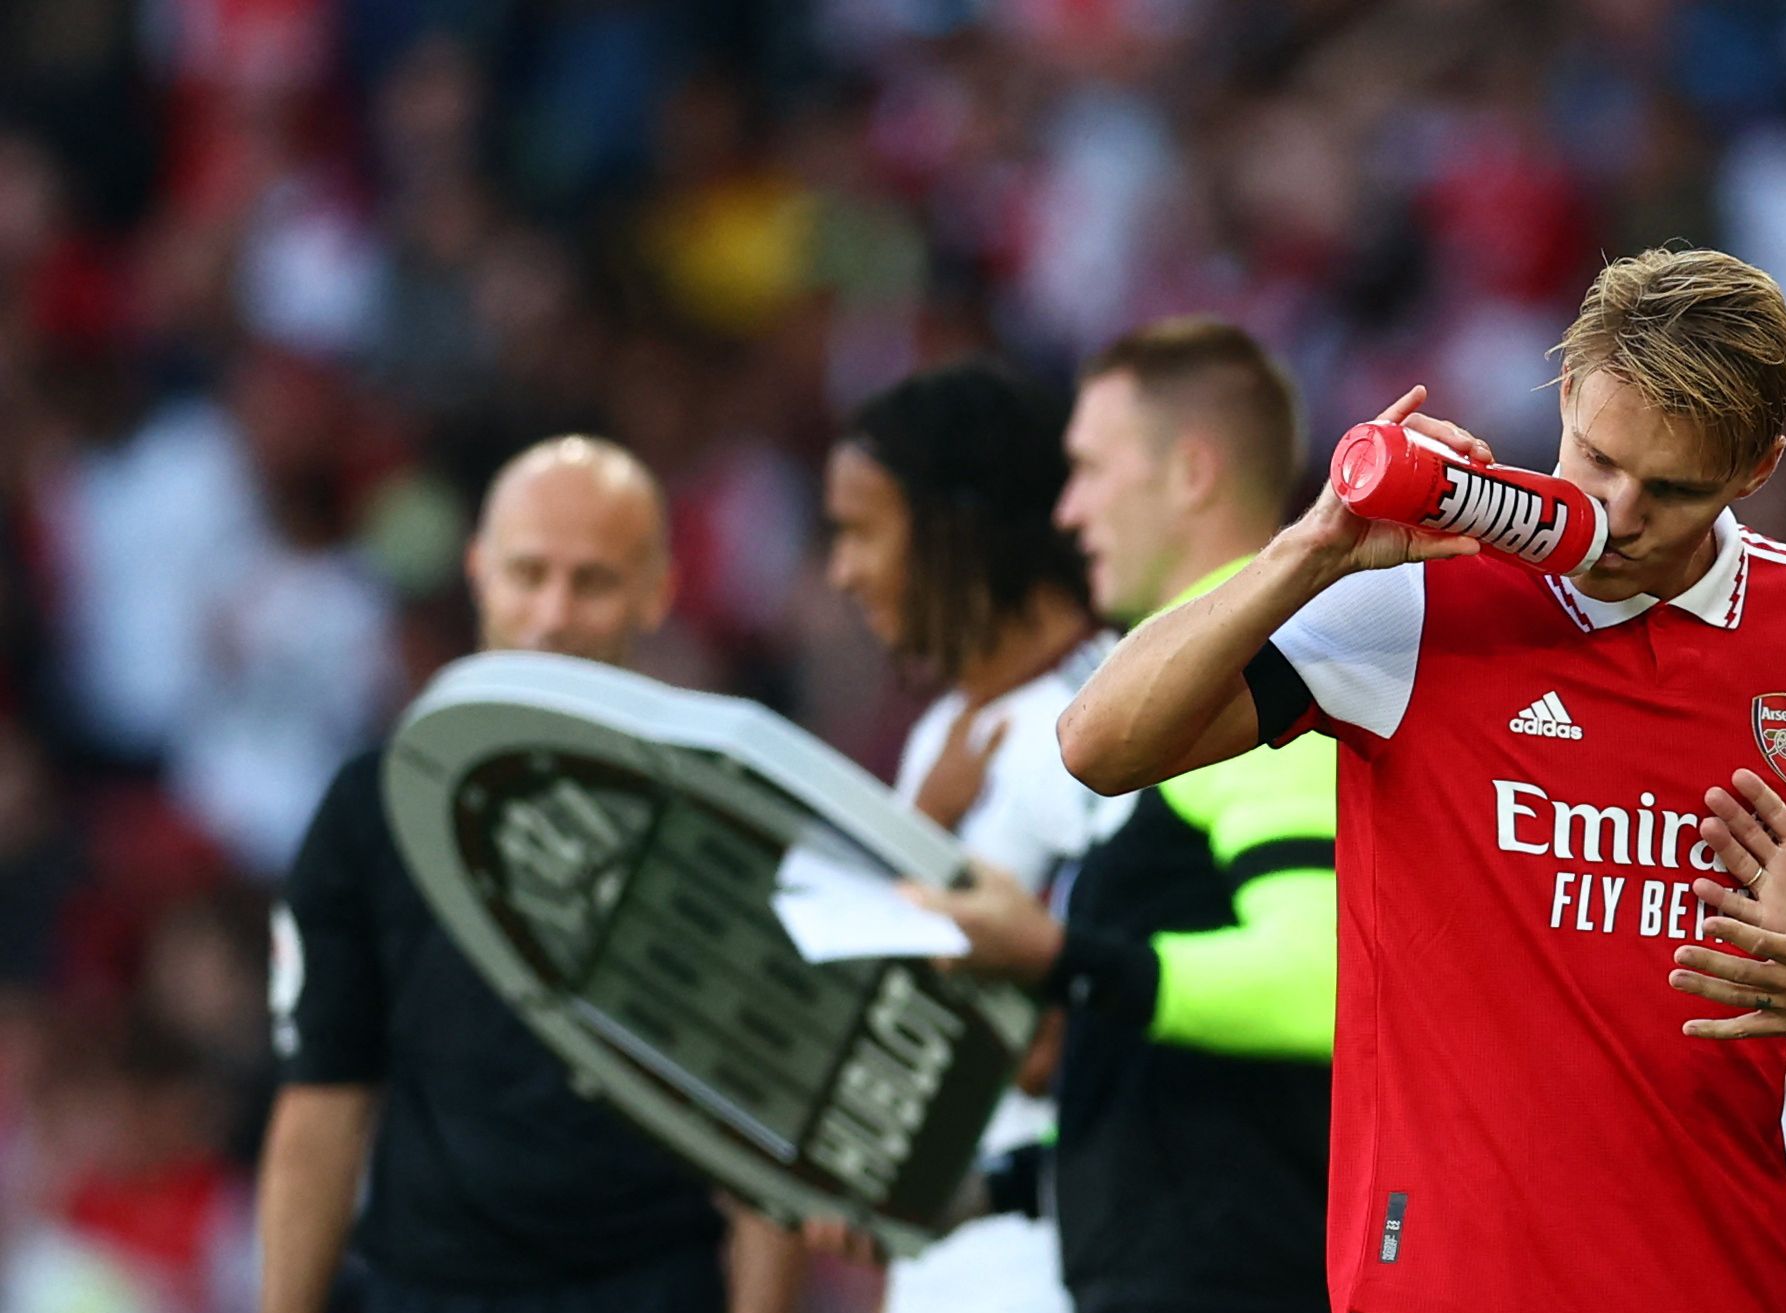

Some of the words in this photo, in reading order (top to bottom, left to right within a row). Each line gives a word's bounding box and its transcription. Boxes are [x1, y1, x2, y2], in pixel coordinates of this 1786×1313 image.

[1422, 466, 1569, 563] PRIME
[1509, 716, 1583, 740] adidas
[1492, 779, 1729, 874] Emira
[1550, 872, 1625, 933] FLY
[804, 966, 966, 1202] HUBLOT
